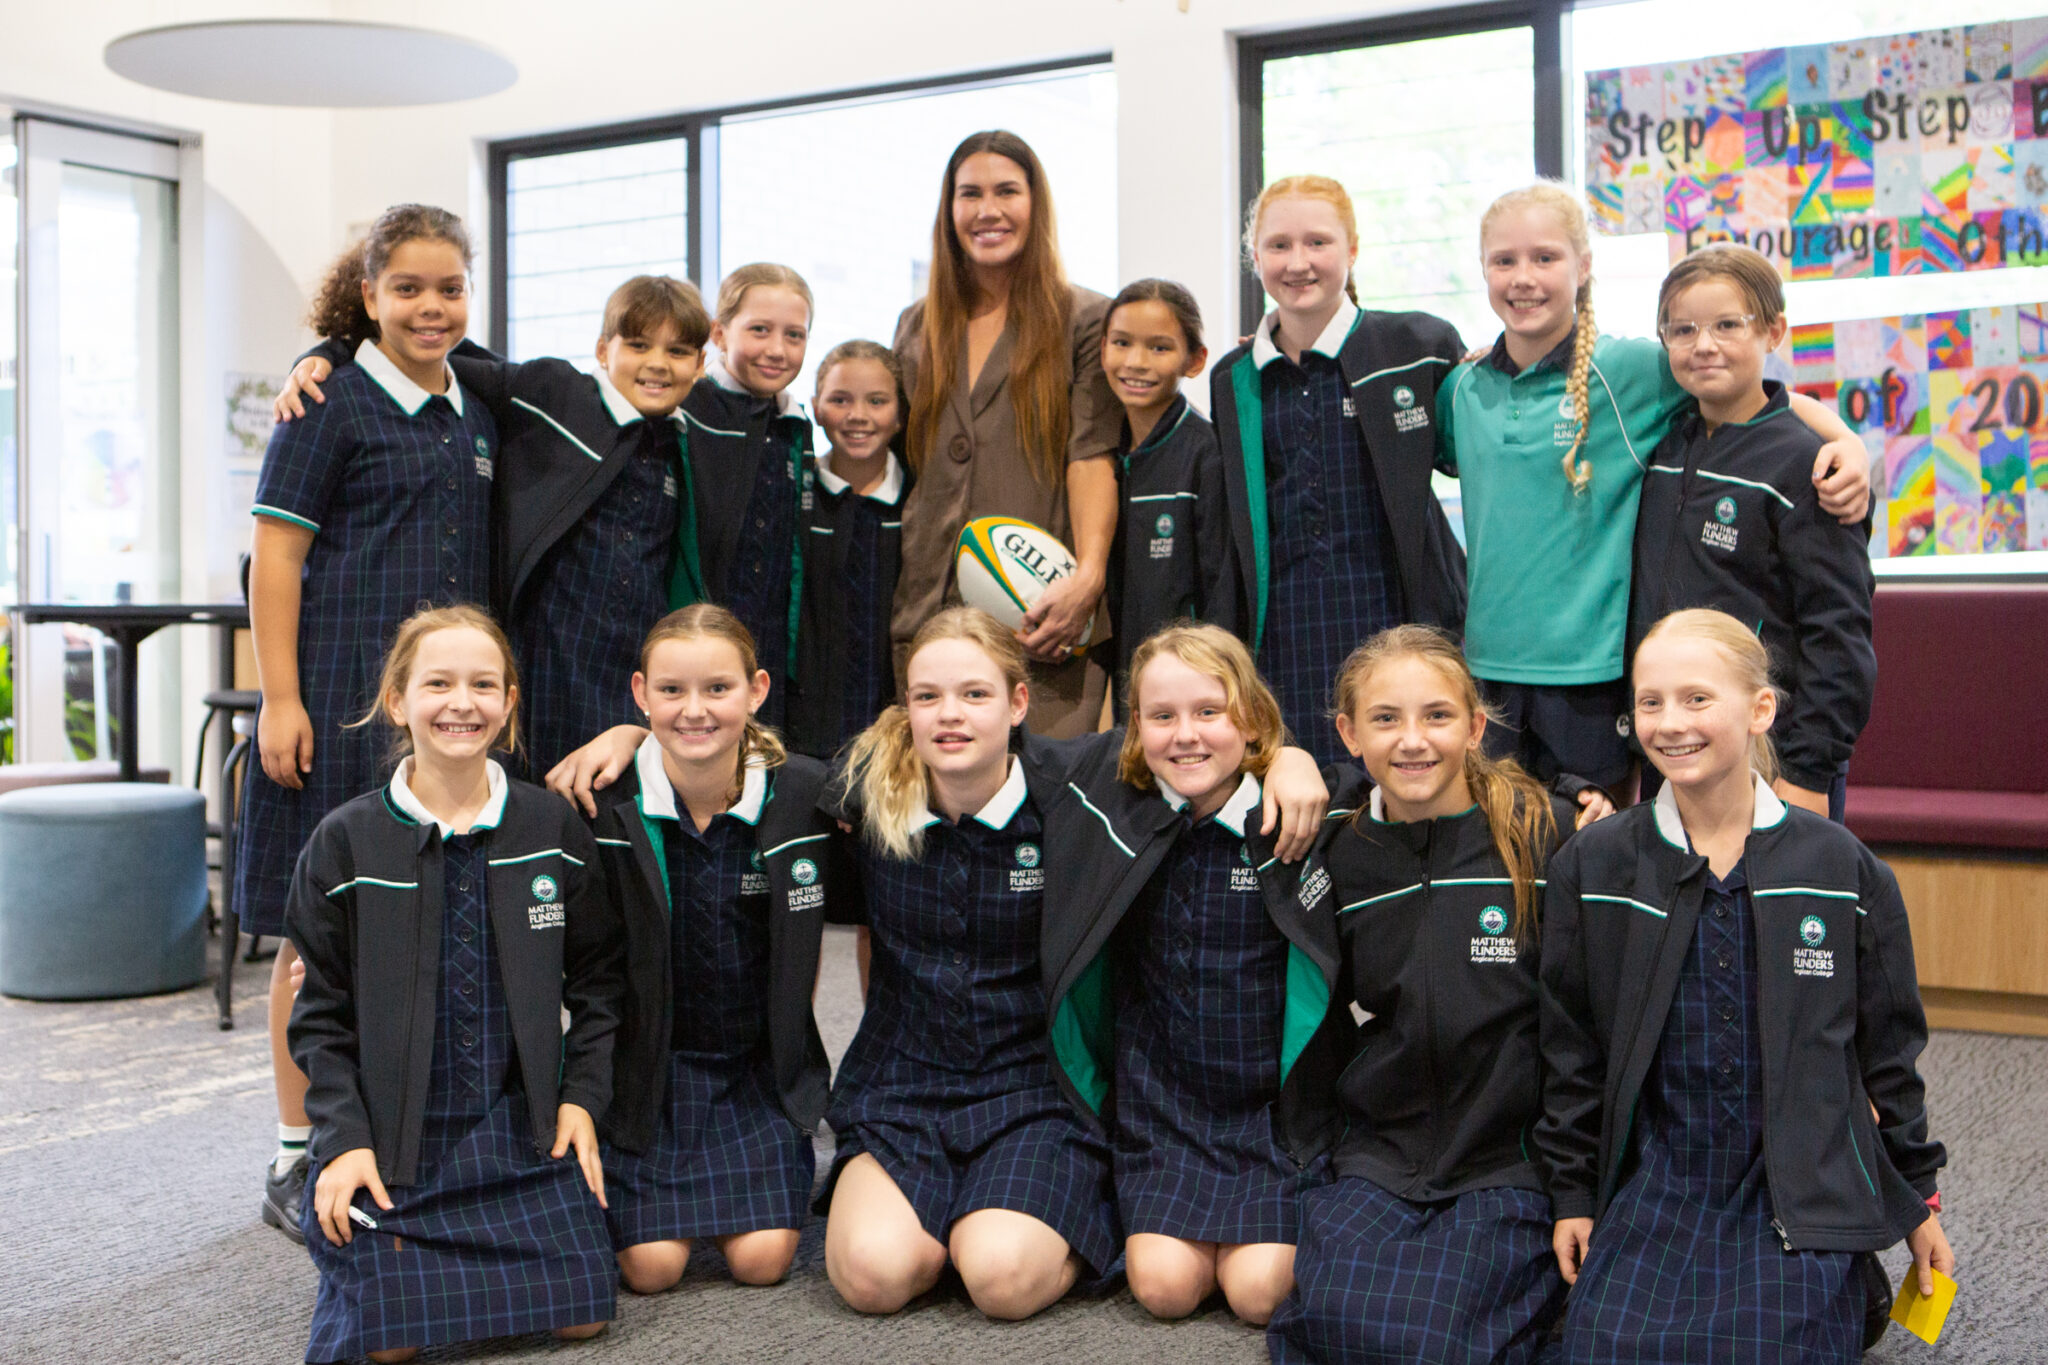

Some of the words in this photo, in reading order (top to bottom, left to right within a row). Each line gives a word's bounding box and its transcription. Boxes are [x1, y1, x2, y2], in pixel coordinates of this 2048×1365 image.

[1608, 109, 1706, 163] Step
[1862, 89, 1970, 144] Step
[1847, 367, 1898, 424] of
[1704, 520, 1739, 536] MATTHEW
[1702, 527, 1737, 545] FLINDERS
[1298, 866, 1325, 900] MATTHEW
[1301, 872, 1331, 907] FLINDERS
[1471, 937, 1515, 946] MATTHEW
[1471, 946, 1516, 956] FLINDERS
[1794, 948, 1834, 959] MATTHEW
[1494, 956, 1516, 964] College
[1794, 957, 1834, 970] FLINDERS
[1812, 969, 1834, 978] College
